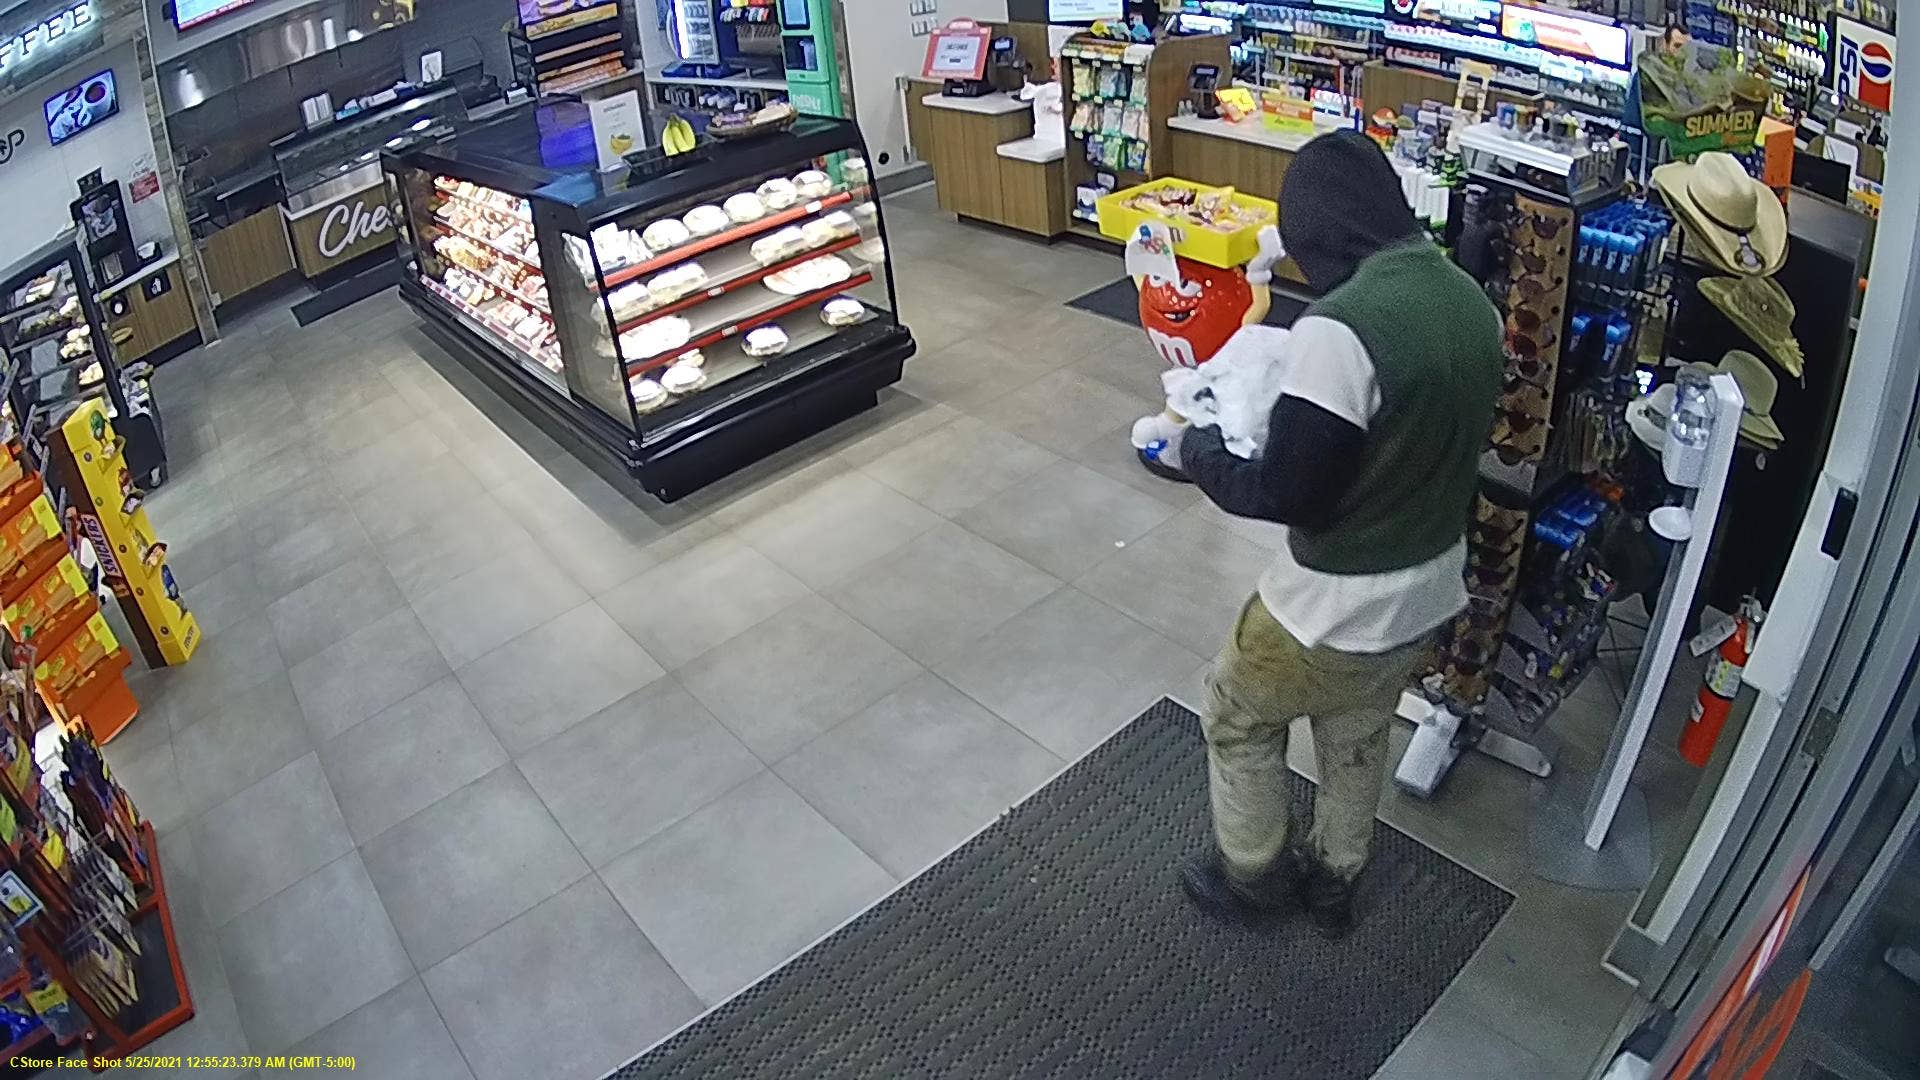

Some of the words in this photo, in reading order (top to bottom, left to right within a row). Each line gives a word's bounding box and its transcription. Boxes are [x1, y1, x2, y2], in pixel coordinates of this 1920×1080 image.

[0, 0, 91, 68] FFEE
[1838, 34, 1858, 99] PSI
[1685, 110, 1755, 138] SUMMER
[83, 517, 119, 574] SNICKERS
